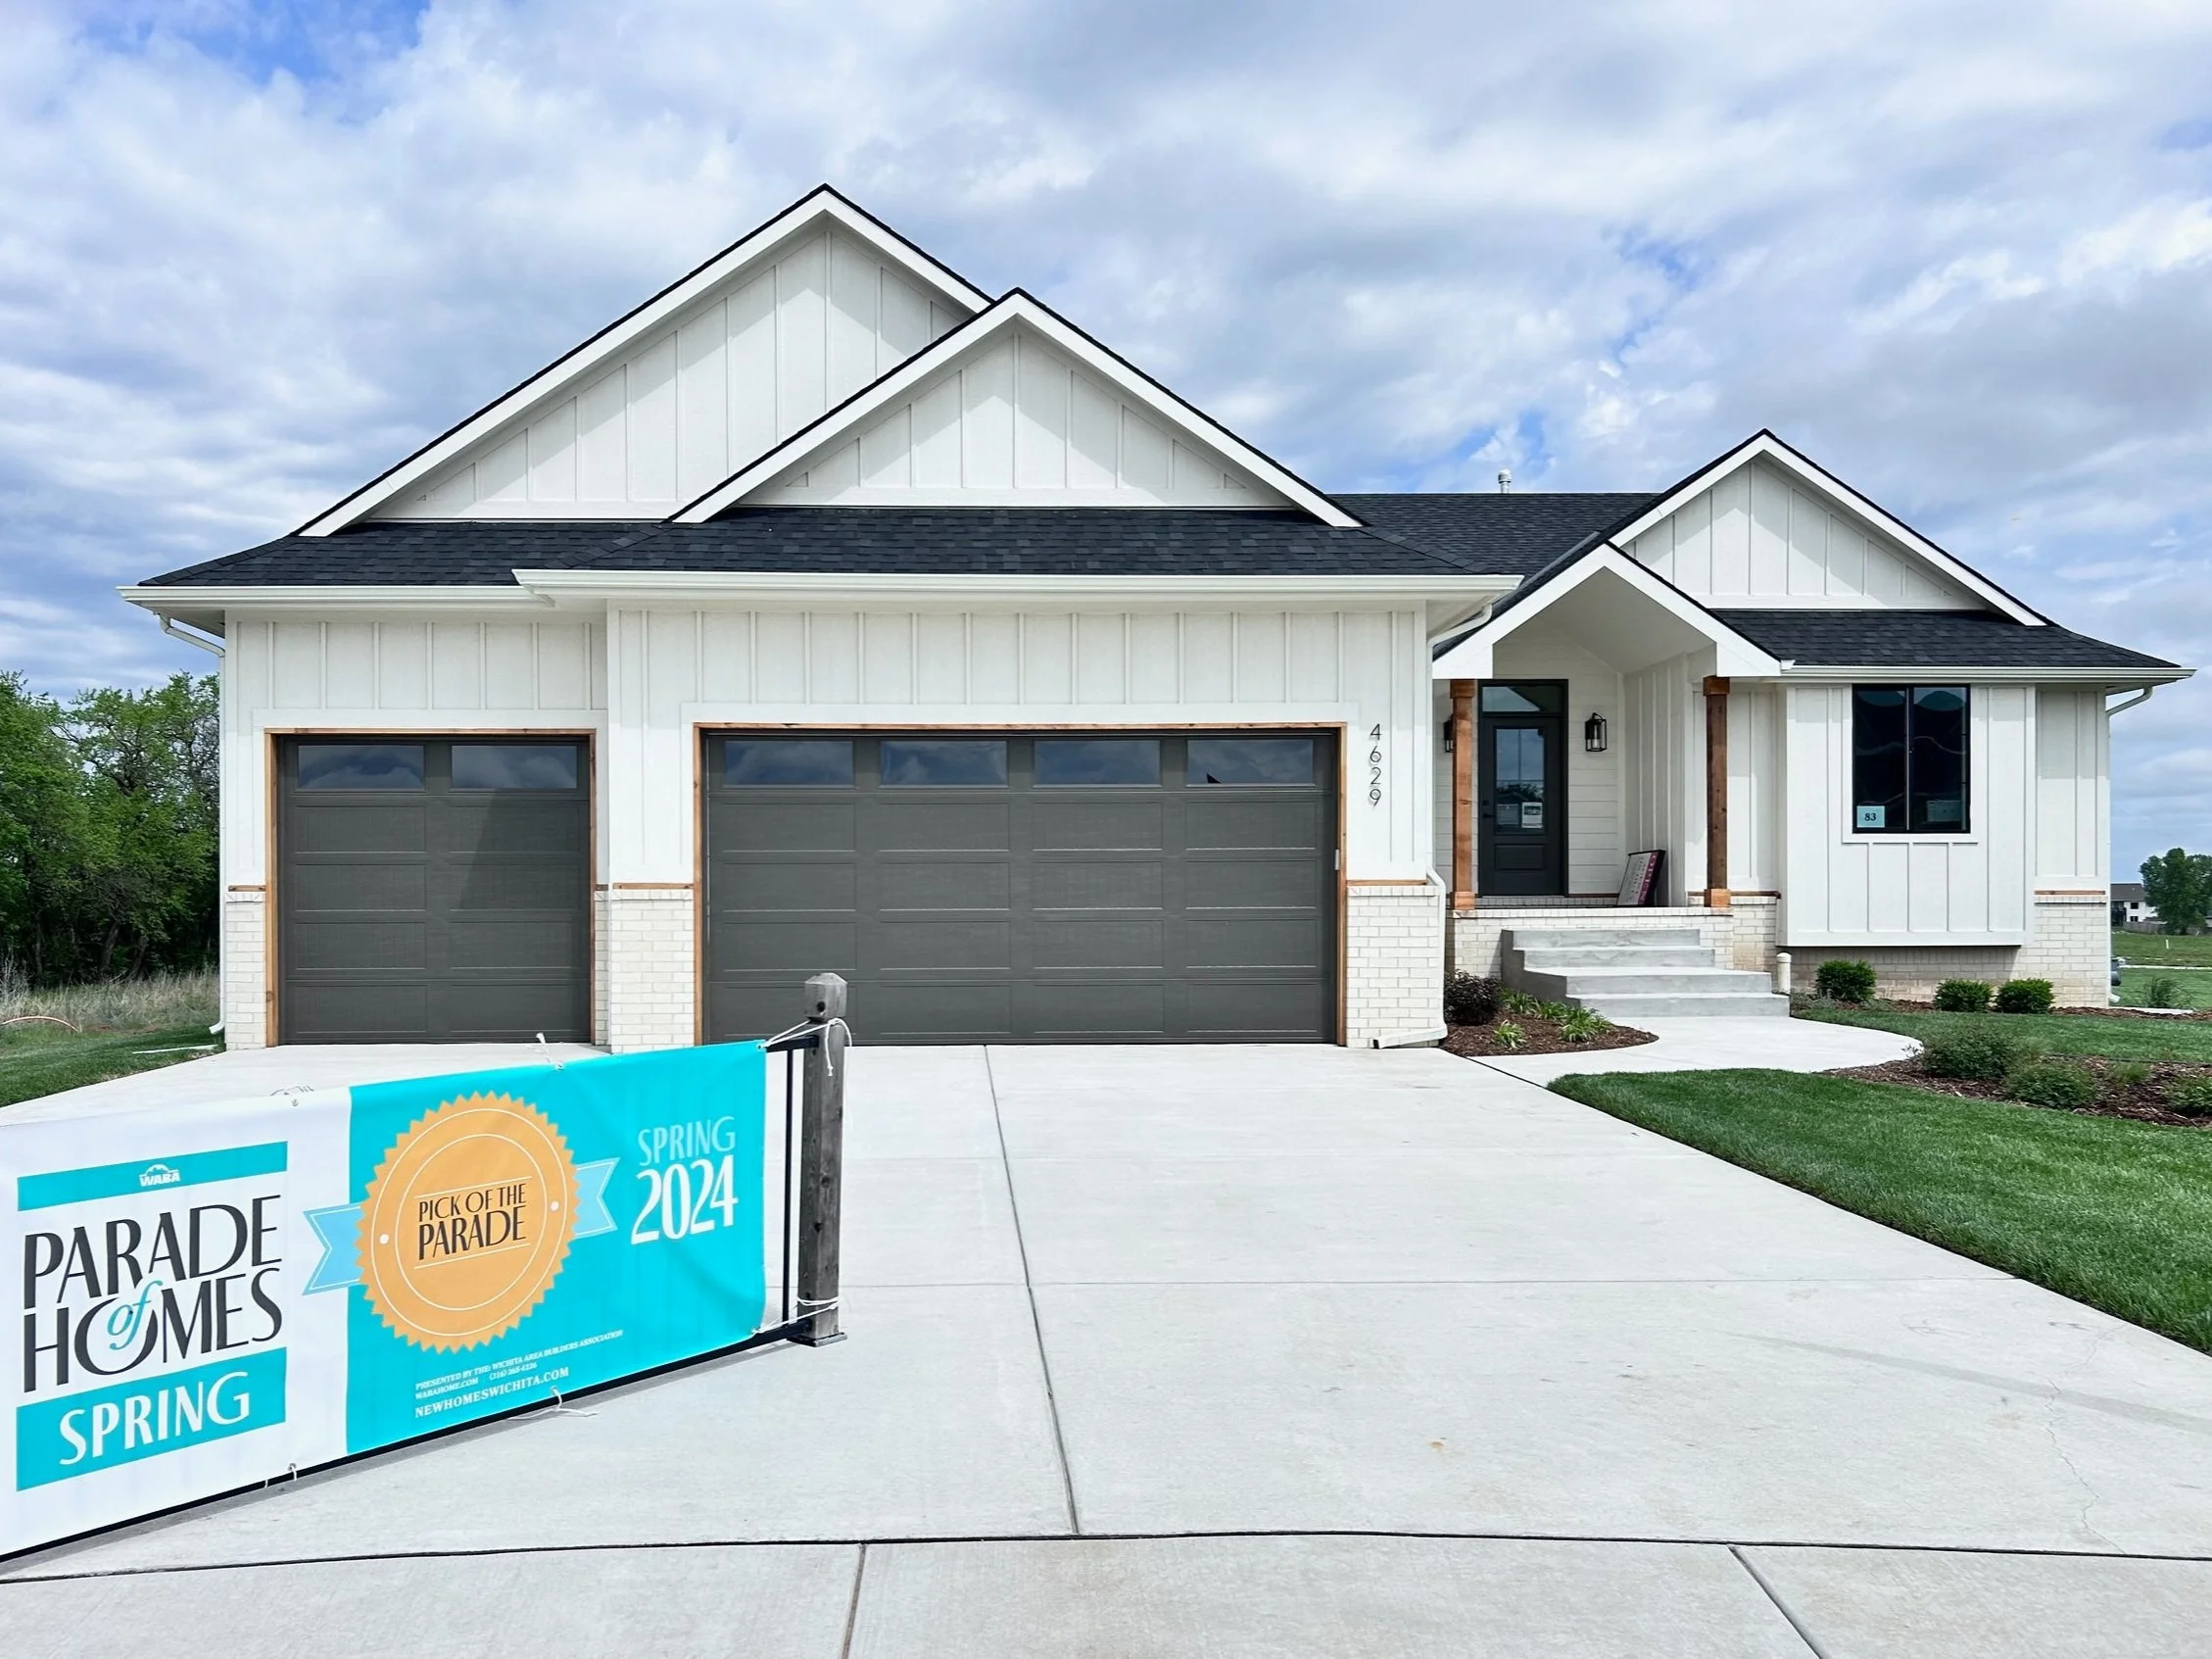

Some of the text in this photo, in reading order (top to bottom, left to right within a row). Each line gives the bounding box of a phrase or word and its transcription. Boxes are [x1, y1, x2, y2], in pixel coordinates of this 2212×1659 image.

[1370, 723, 1383, 806] 4629
[1864, 812, 1877, 821] 83
[638, 1115, 737, 1166] SPRING
[418, 1183, 527, 1222] PICK OF THE
[418, 1205, 527, 1260] PARADE
[630, 1154, 740, 1245] 2024
[24, 1195, 282, 1310] PARADE
[24, 1267, 283, 1393] HOMES
[107, 1280, 163, 1350] of
[414, 1366, 569, 1419] NEWHOMESWICHITA.COM
[415, 1373, 461, 1391] PRESENTED
[461, 1369, 474, 1379] BY
[492, 1356, 523, 1370] WICHITA
[524, 1350, 545, 1363] AREA
[544, 1341, 579, 1357] BUILDERS
[579, 1329, 624, 1347] ASSOCIATION
[59, 1371, 251, 1465] SPRING
